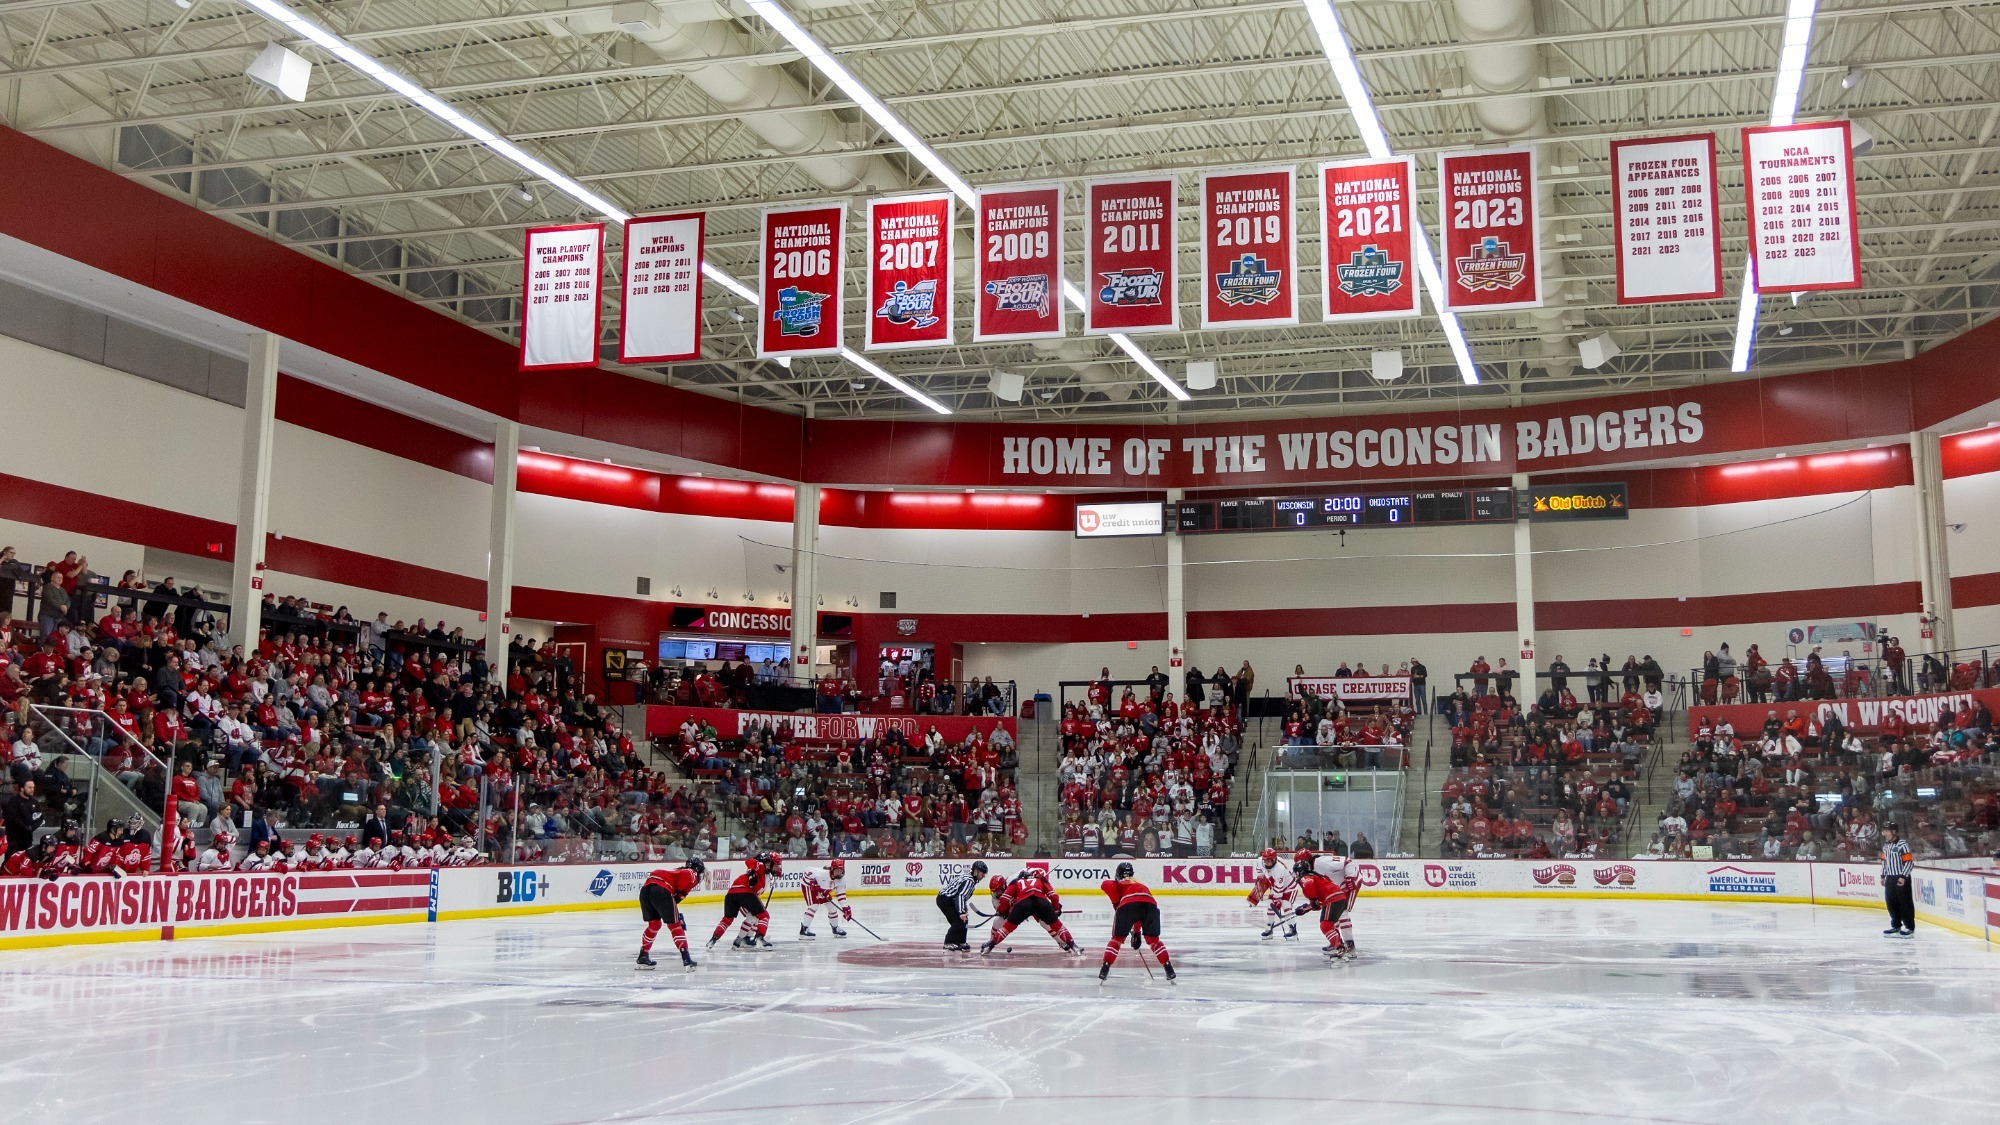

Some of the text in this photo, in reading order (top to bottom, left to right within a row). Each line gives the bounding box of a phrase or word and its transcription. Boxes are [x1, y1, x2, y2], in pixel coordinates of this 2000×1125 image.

[1783, 147, 1810, 157] NCAA
[1628, 158, 1698, 171] FROZEN FOUR
[1759, 156, 1836, 170] TOURNAMENTS
[1453, 168, 1521, 185] NATIONAL
[1627, 168, 1700, 182] APPEARANCES
[1760, 172, 1837, 186] 2005 2006 2007
[1334, 178, 1400, 195] NATIONAL
[1453, 182, 1522, 197] CHAMPIONS
[1628, 184, 1702, 198] 2006 2007 2008
[1215, 188, 1280, 203] NATIONAL
[1334, 190, 1400, 206] CHAMPIONS
[1761, 187, 1837, 201] 2008 2009 2011
[1101, 196, 1163, 211] NATIONAL
[1215, 200, 1281, 215] CHAMPIONS
[1628, 199, 1702, 213] 2009 2011 2012
[1762, 202, 1839, 216] 2012 2014 2015
[988, 205, 1048, 220] NATIONAL
[1101, 209, 1163, 223] CHAMPIONS
[1454, 197, 1523, 230] 2023
[880, 214, 939, 230] NATIONAL
[988, 217, 1049, 232] CHAMPIONS
[1338, 205, 1402, 238] 2021
[1629, 213, 1704, 227] 2014 2015 2016
[1763, 217, 1840, 230] 2016 2017 2018
[774, 224, 831, 238] NATIONAL
[880, 226, 939, 240] CHAMPIONS
[1103, 223, 1160, 253] 2011
[1217, 215, 1281, 247] 2019
[1630, 227, 1705, 241] 2017 2018 2019
[1764, 231, 1840, 245] 2019 2020 2021
[651, 235, 674, 245] WCHA
[774, 234, 831, 249] CHAMPIONS
[988, 231, 1049, 262] 2009
[536, 244, 591, 255] WCHA PLAYOFF
[640, 243, 685, 255] CHAMPIONS
[879, 241, 939, 271] 2007
[1632, 244, 1680, 256] 2021 2023
[1765, 247, 1816, 260] 2022 2023
[542, 253, 584, 264] CHAMPIONS
[654, 259, 671, 268] 2007
[674, 258, 691, 267] 2011
[773, 249, 830, 279] 2006
[1464, 262, 1496, 271] FROZEN
[1497, 260, 1518, 269] FOUR
[555, 269, 571, 278] 2007
[633, 271, 691, 283] 2012 2017
[1344, 268, 1375, 278] FROZEN
[1375, 267, 1397, 276] FOUR
[534, 283, 549, 292] 2011
[996, 281, 1045, 294] FROZEN
[1107, 274, 1161, 287] FROZEN
[1223, 276, 1275, 287] FROZEN FOUR
[653, 283, 690, 293] 2020 2021
[533, 295, 549, 304] 2017
[574, 293, 589, 302] 2021
[896, 293, 933, 304] FROZEN
[998, 290, 1042, 308] FOUR
[774, 305, 821, 320] FROZEN
[896, 300, 930, 314] FOUR
[787, 312, 820, 324] FOUR
[1002, 402, 1704, 477] HOME OF THE WISCONSIN BADGERS
[1416, 492, 1435, 500] PLAYER
[1549, 495, 1606, 510] Old Dutch
[1277, 501, 1314, 511] WISCONSIN
[1324, 497, 1361, 511] 20:00
[1102, 518, 1160, 527] credit union
[1295, 513, 1305, 525] 0
[1326, 515, 1347, 523] PERIOD
[1389, 509, 1398, 522] 0
[1342, 682, 1406, 694] CREATURES
[619, 872, 631, 880] FIBER
[861, 865, 882, 875] 1070
[1055, 868, 1111, 879] TOYOTA
[1448, 871, 1476, 879] credit
[594, 877, 608, 889] TDS
[863, 875, 891, 884] GAME
[1017, 879, 1037, 889] 17
[1750, 877, 1775, 885] FAMILY
[1847, 872, 1876, 886] Dave Jones
[429, 870, 438, 913] CCM
[617, 884, 627, 892] TDS
[1945, 877, 1963, 901] WILDE
[0, 876, 298, 932] WISCONSIN BADGERS
